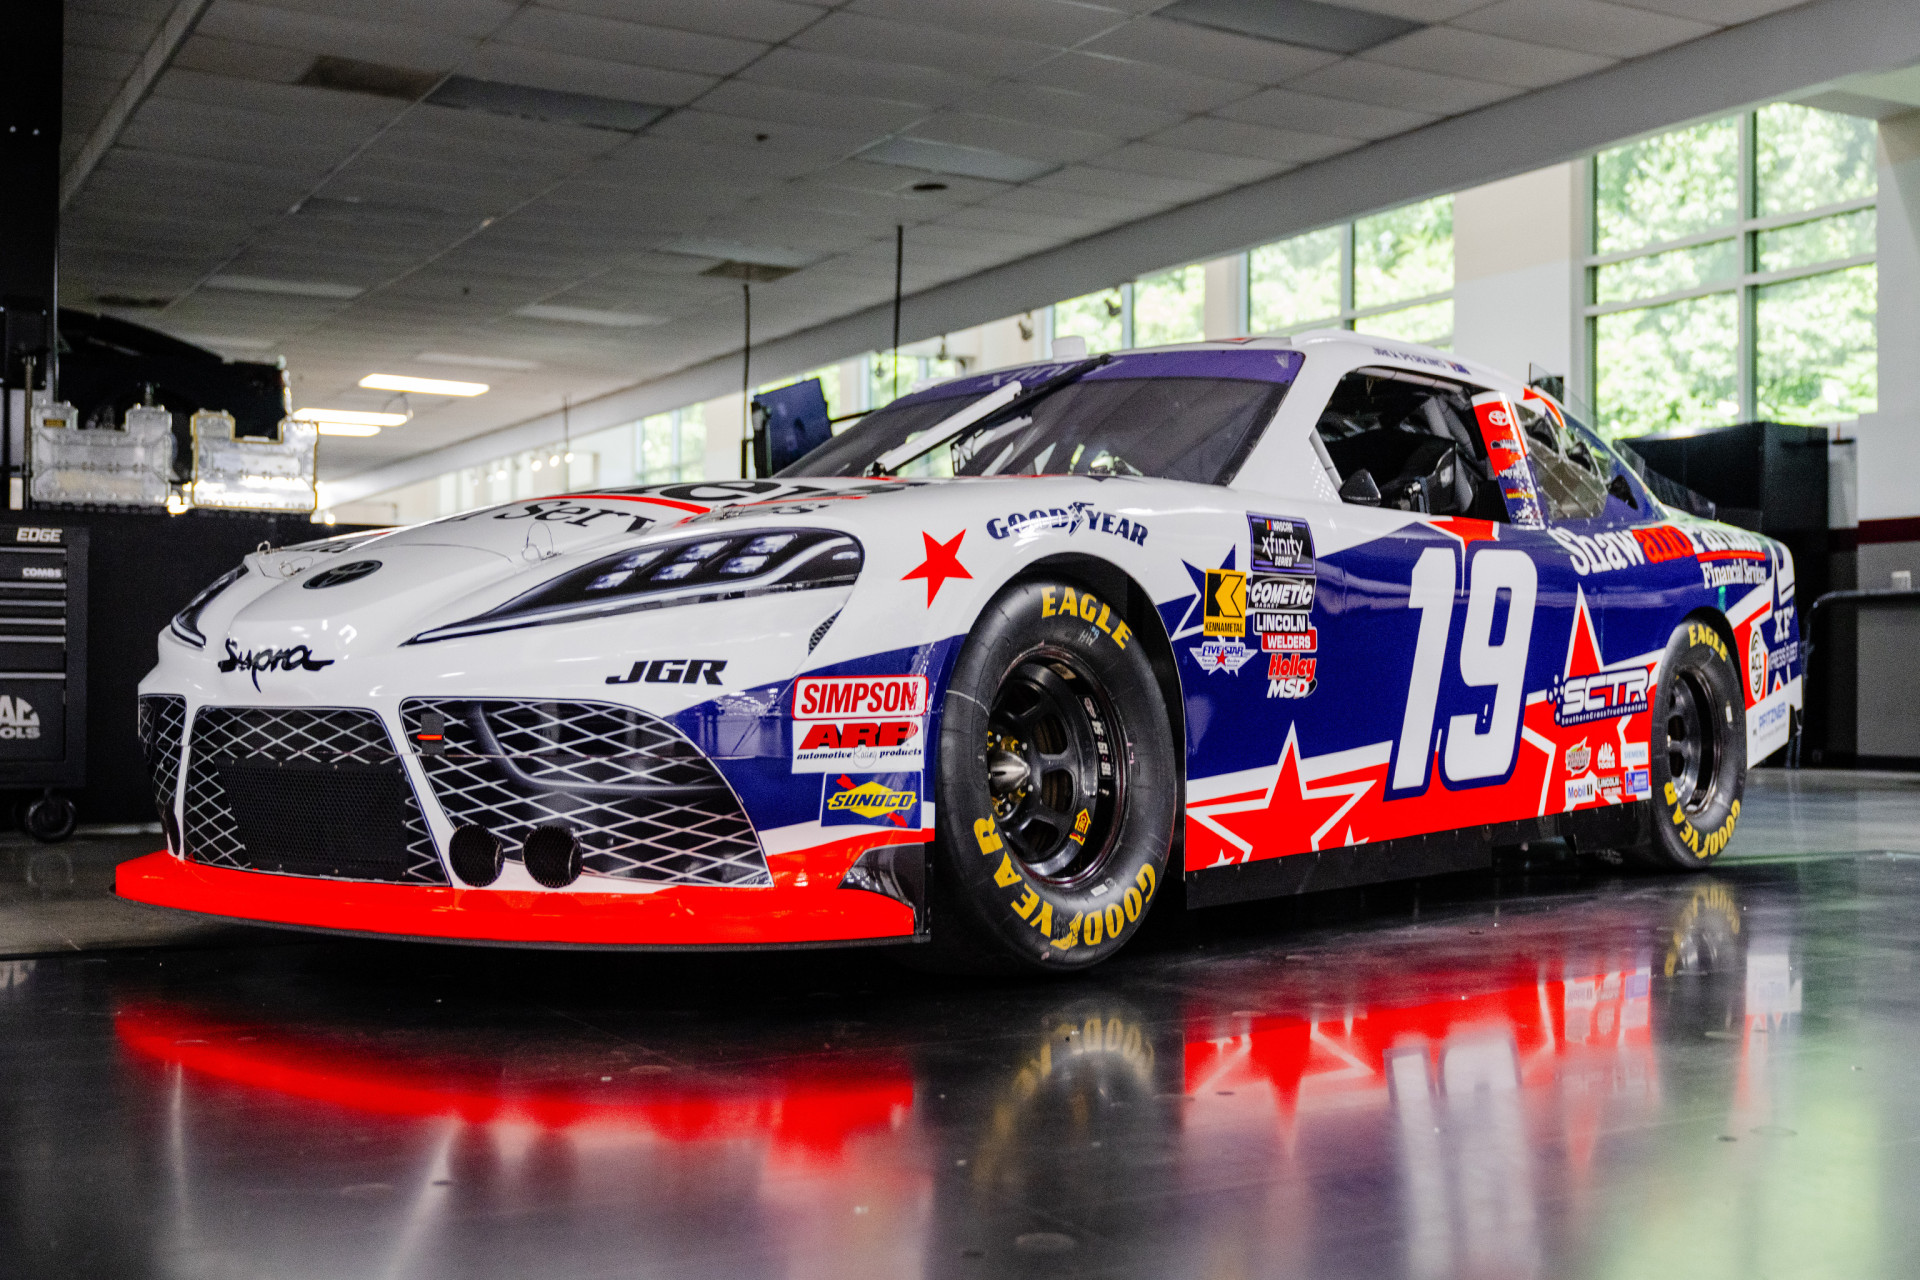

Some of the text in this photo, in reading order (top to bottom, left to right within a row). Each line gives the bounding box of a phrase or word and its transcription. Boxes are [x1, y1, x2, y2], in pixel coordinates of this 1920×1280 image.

[16, 527, 63, 543] EDGE
[986, 502, 1149, 547] GOODYEAR
[1273, 520, 1294, 533] NASCAR
[1261, 534, 1304, 562] xfinity
[1274, 555, 1294, 567] SERIES
[22, 567, 63, 579] COMBS
[1701, 558, 1744, 589] Financial
[1250, 582, 1313, 607] COMETIC
[1040, 585, 1133, 651] EAGLE
[1205, 622, 1243, 634] KENNAMETAL
[1256, 613, 1307, 632] LINCOLN
[1202, 645, 1244, 657] FIVE STAR
[1267, 635, 1311, 649] WELDERS
[1688, 623, 1728, 662] EAGLE
[218, 637, 335, 693] Supra
[605, 659, 728, 686] JGR
[1268, 654, 1316, 682] Holley
[1392, 547, 1538, 790] 19
[1751, 653, 1762, 673] ACL
[801, 681, 919, 714] SIMPSON
[1267, 679, 1311, 699] MSD
[1562, 668, 1649, 716] SCTR
[799, 721, 919, 750] ARP
[797, 751, 852, 761] automotive
[879, 748, 922, 759] products
[1624, 750, 1646, 760] SIEMENS
[832, 793, 914, 808] SUNOCO
[1568, 785, 1586, 798] Mobil
[973, 814, 1157, 951] GOODYEAR
